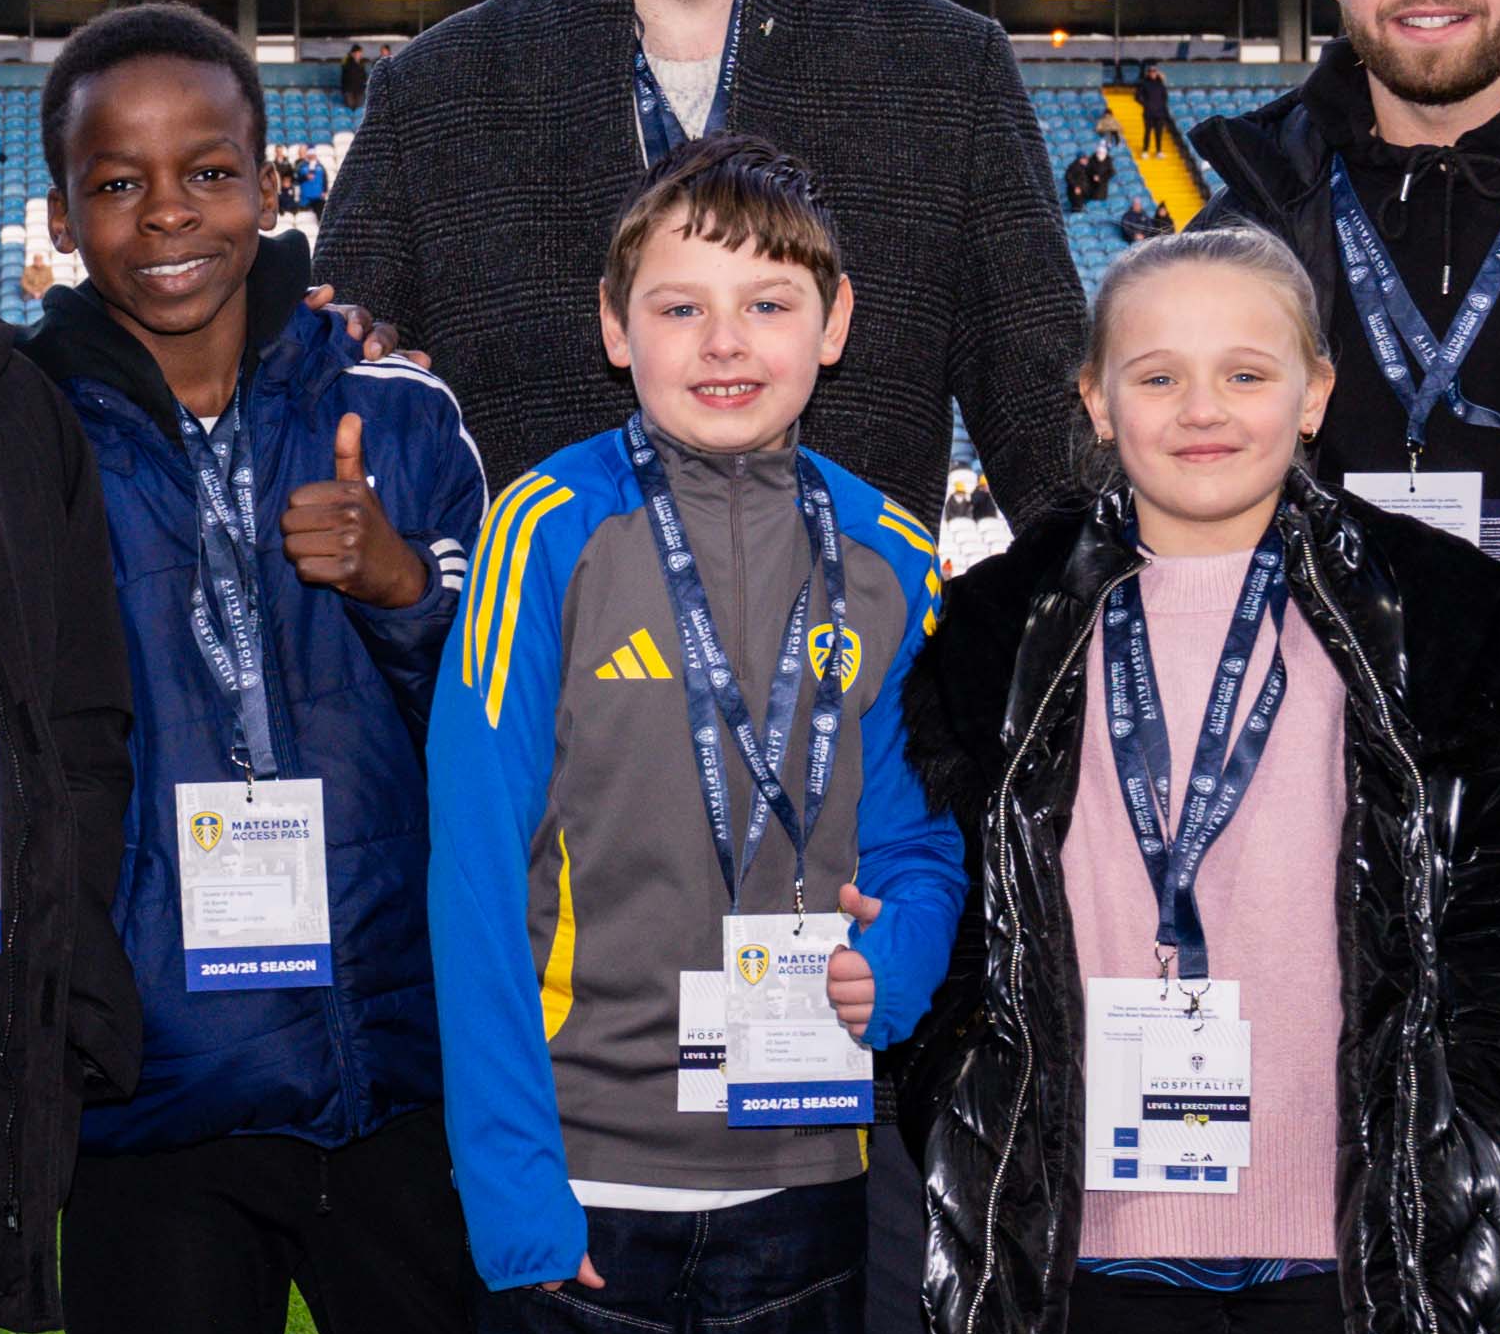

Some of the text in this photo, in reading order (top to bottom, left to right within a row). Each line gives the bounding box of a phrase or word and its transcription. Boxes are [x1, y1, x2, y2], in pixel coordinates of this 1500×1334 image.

[1367, 315, 1391, 363] LEEDS UNITED
[1373, 313, 1397, 362] HOSPITALITY
[1442, 310, 1473, 361] HOSPITALITY
[1449, 311, 1481, 363] LEEDS UNITED
[652, 495, 677, 551] LEEDS UNITED
[660, 495, 683, 549] HOSPITALITY
[1241, 568, 1261, 619] HOSPITALITY
[1248, 569, 1270, 621] LEEDS UNITED
[194, 608, 240, 691] HOSPITALITY
[225, 579, 253, 668] HOSPITALITY
[1112, 662, 1122, 716] LEEDS UNITED
[1119, 662, 1128, 715] HOSPITALITY
[1130, 639, 1154, 720] HOSPITALITY
[1209, 677, 1229, 734] HOSPITALITY
[1216, 678, 1238, 735] LEEDS UNITED
[811, 735, 822, 793] HOSPITALITY
[816, 736, 829, 795] LEEDS UNITED
[700, 748, 727, 839] HOSPITALITY
[1127, 778, 1148, 835] LEEDS UNITED
[1134, 777, 1154, 835] HOSPITALITY
[232, 819, 309, 830] MATCHDAY
[232, 829, 310, 841] ACCESS PASS
[1186, 785, 1236, 871] HOSPITALITY
[201, 960, 317, 976] 2024/25 SEASON
[778, 954, 826, 964] MATCH
[778, 965, 823, 975] ACCESS
[683, 1052, 708, 1060] LEVEL
[742, 1096, 859, 1111] 2024/25 SEASON
[1146, 1102, 1172, 1110] LEVEL
[1181, 1103, 1227, 1111] EXECUTIVE
[1229, 1103, 1248, 1111] BOX
[1151, 1081, 1244, 1091] HOSPITALITY
